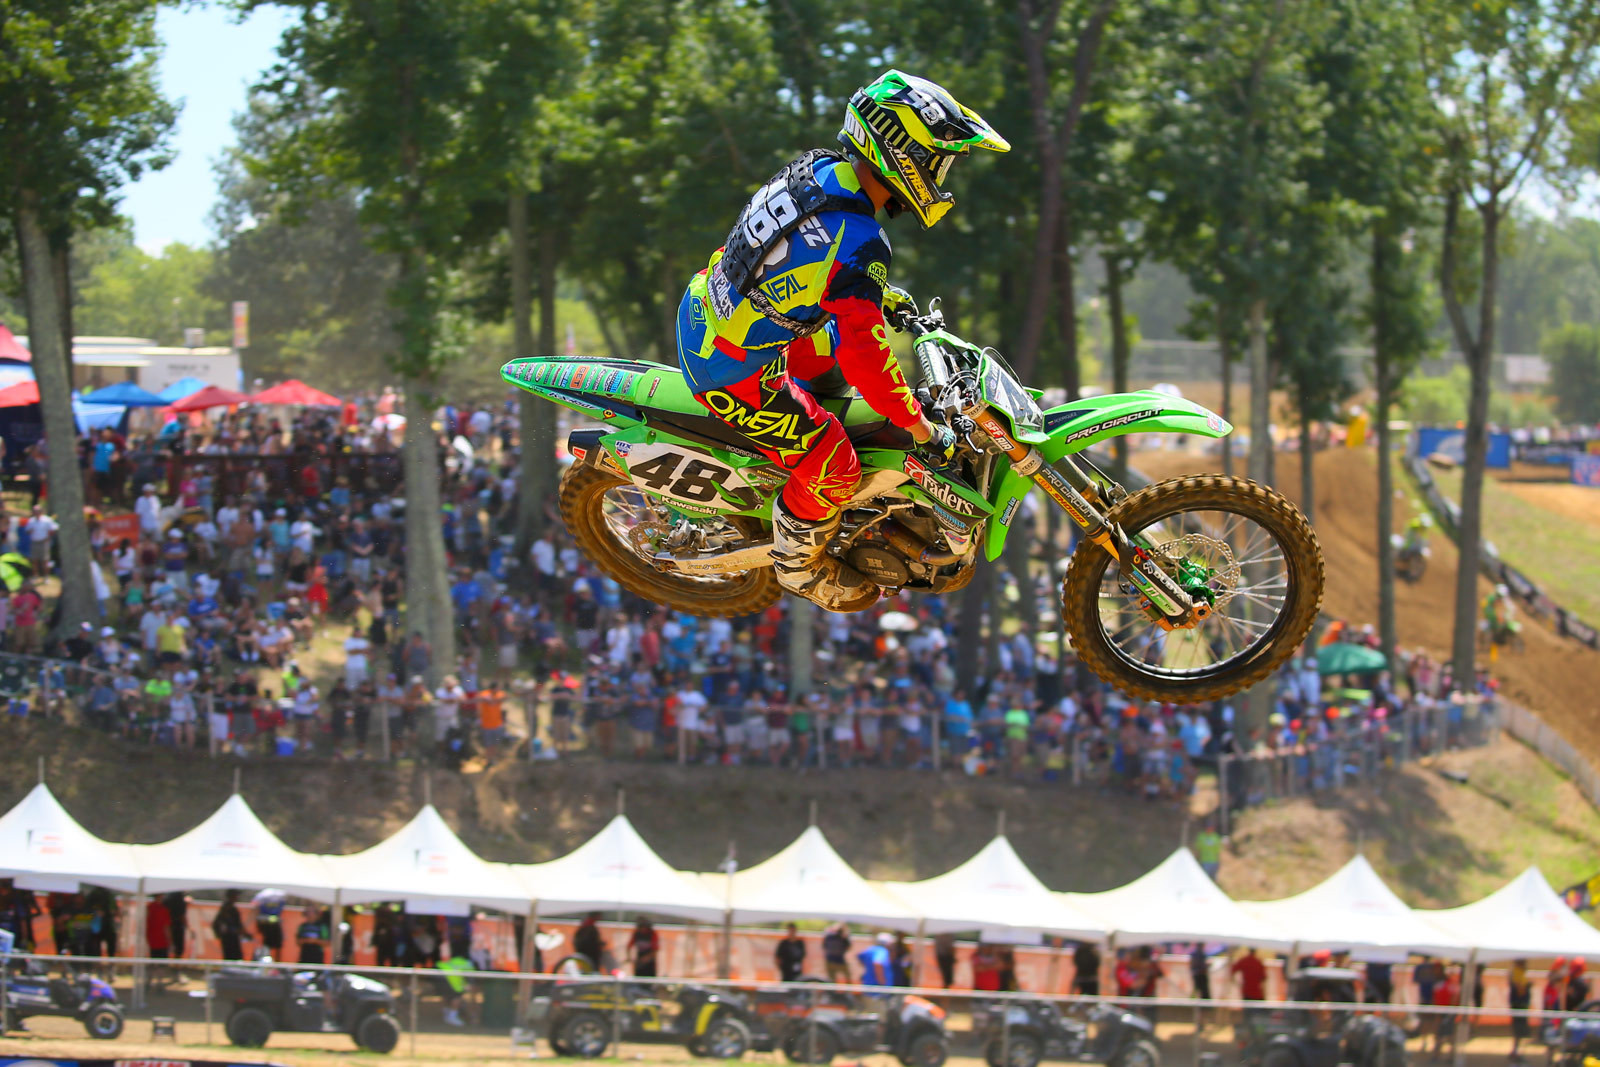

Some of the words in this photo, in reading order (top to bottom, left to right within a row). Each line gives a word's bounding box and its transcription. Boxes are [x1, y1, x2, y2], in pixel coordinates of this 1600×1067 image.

[984, 420, 1004, 438] SFF
[1067, 424, 1099, 443] PRO
[1100, 409, 1163, 431] CIRCUIT
[629, 452, 731, 502] 48
[1041, 467, 1061, 488] PRO
[661, 496, 718, 515] Kawasaki
